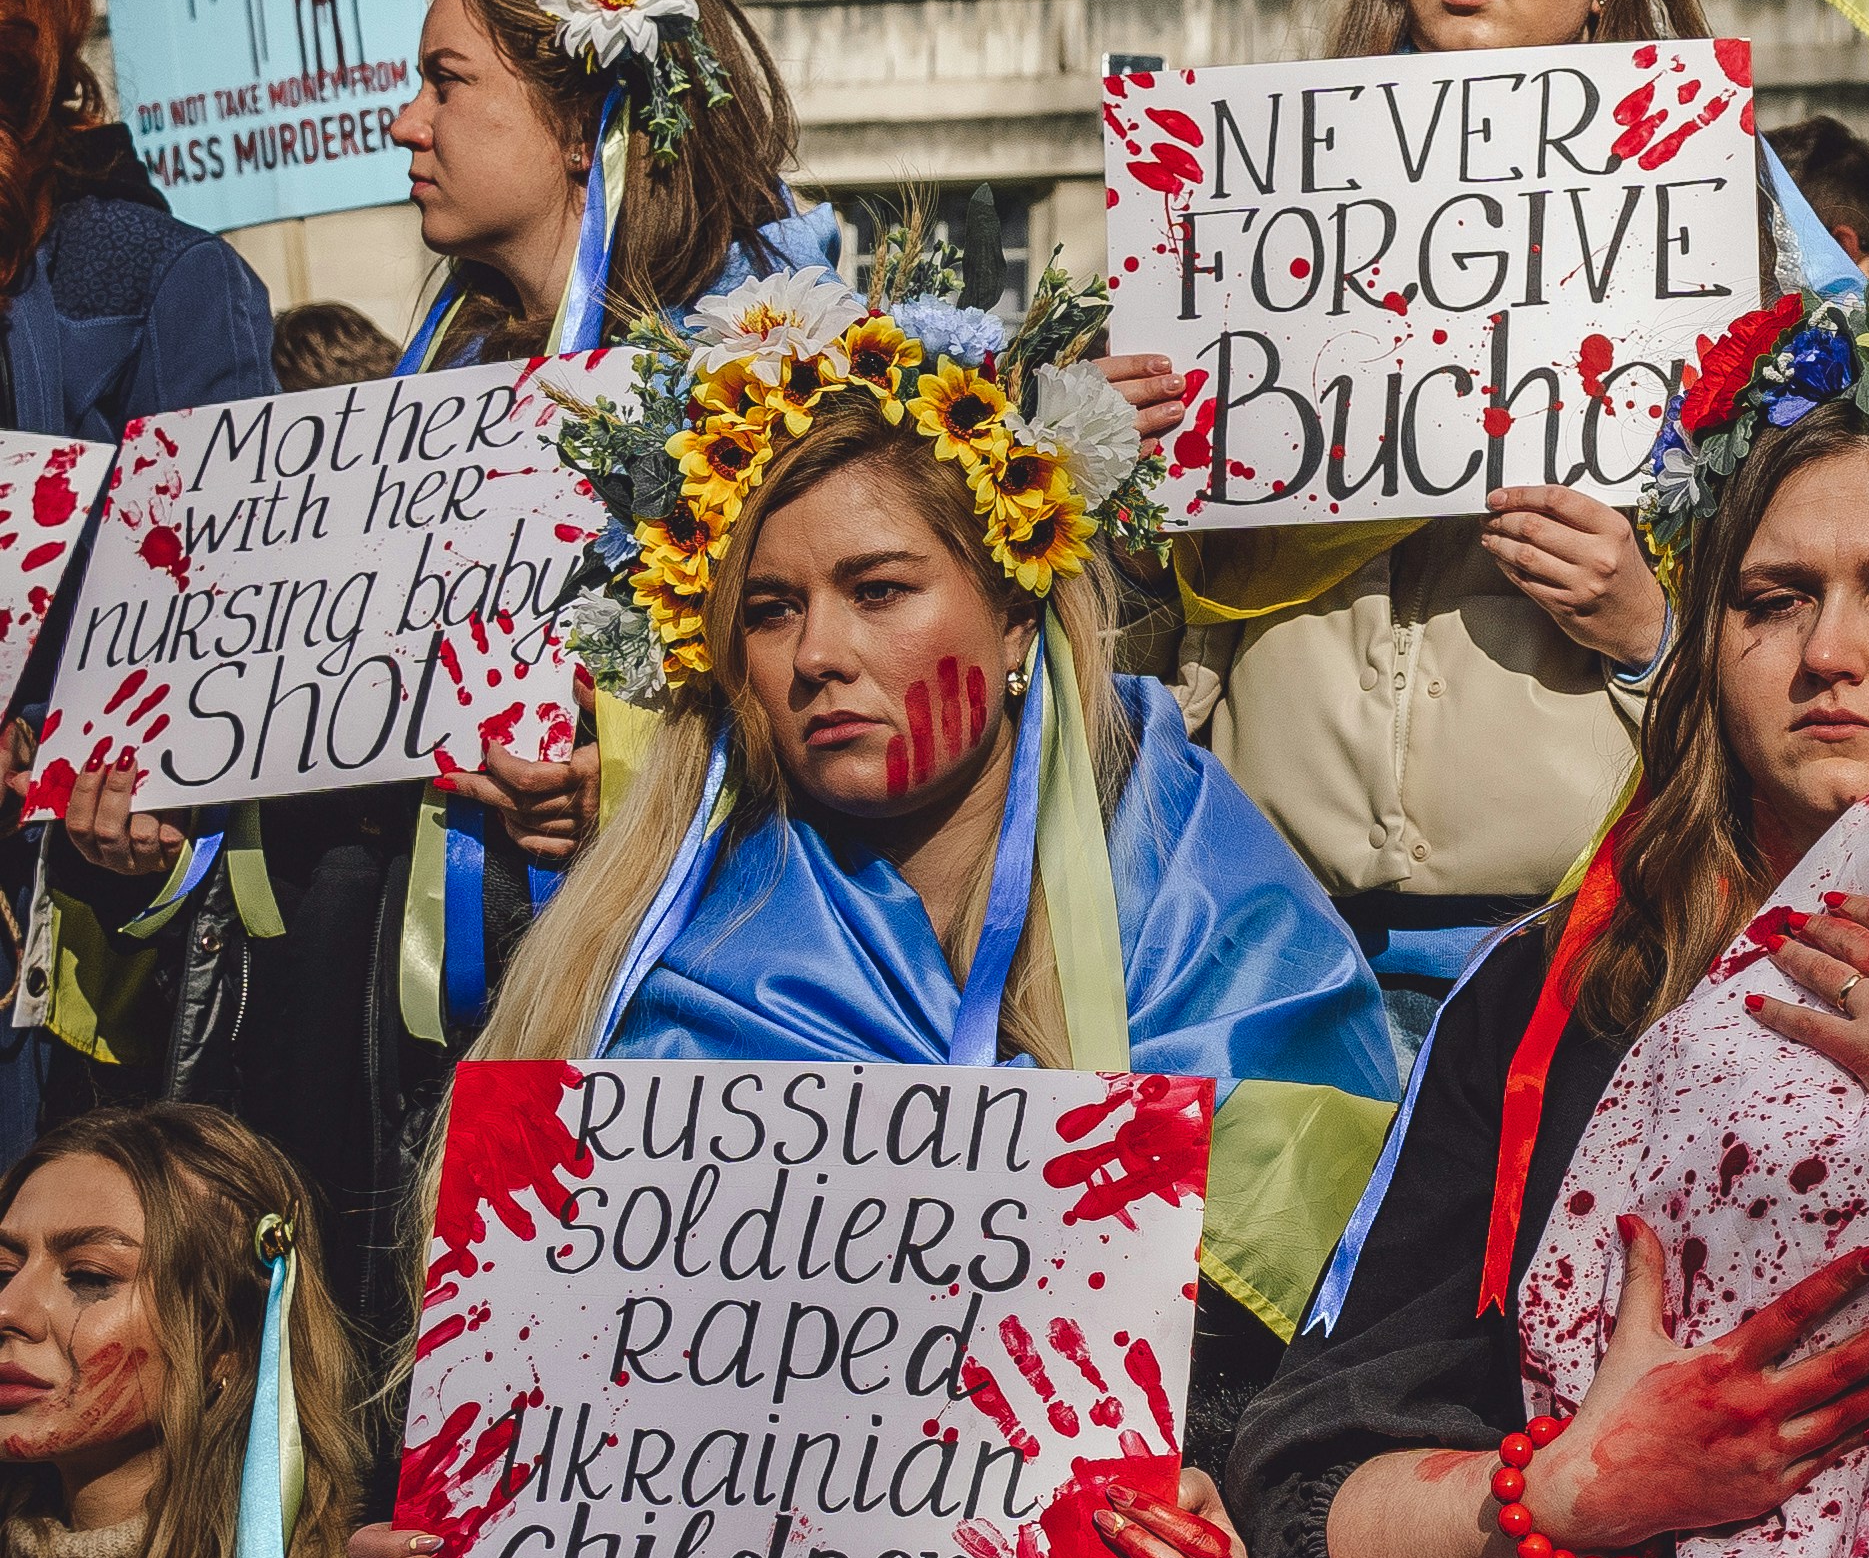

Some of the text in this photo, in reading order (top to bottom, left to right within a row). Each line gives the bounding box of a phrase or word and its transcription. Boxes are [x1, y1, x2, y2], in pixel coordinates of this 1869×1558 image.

[138, 59, 410, 135] DO NOT TAKE MONEY FROM
[144, 102, 410, 187] MASS MURDERER
[1210, 68, 1622, 200] NEVER
[1177, 177, 1732, 320] FORGIVE
[1196, 311, 1685, 511] Bucha
[396, 518, 581, 665] baby
